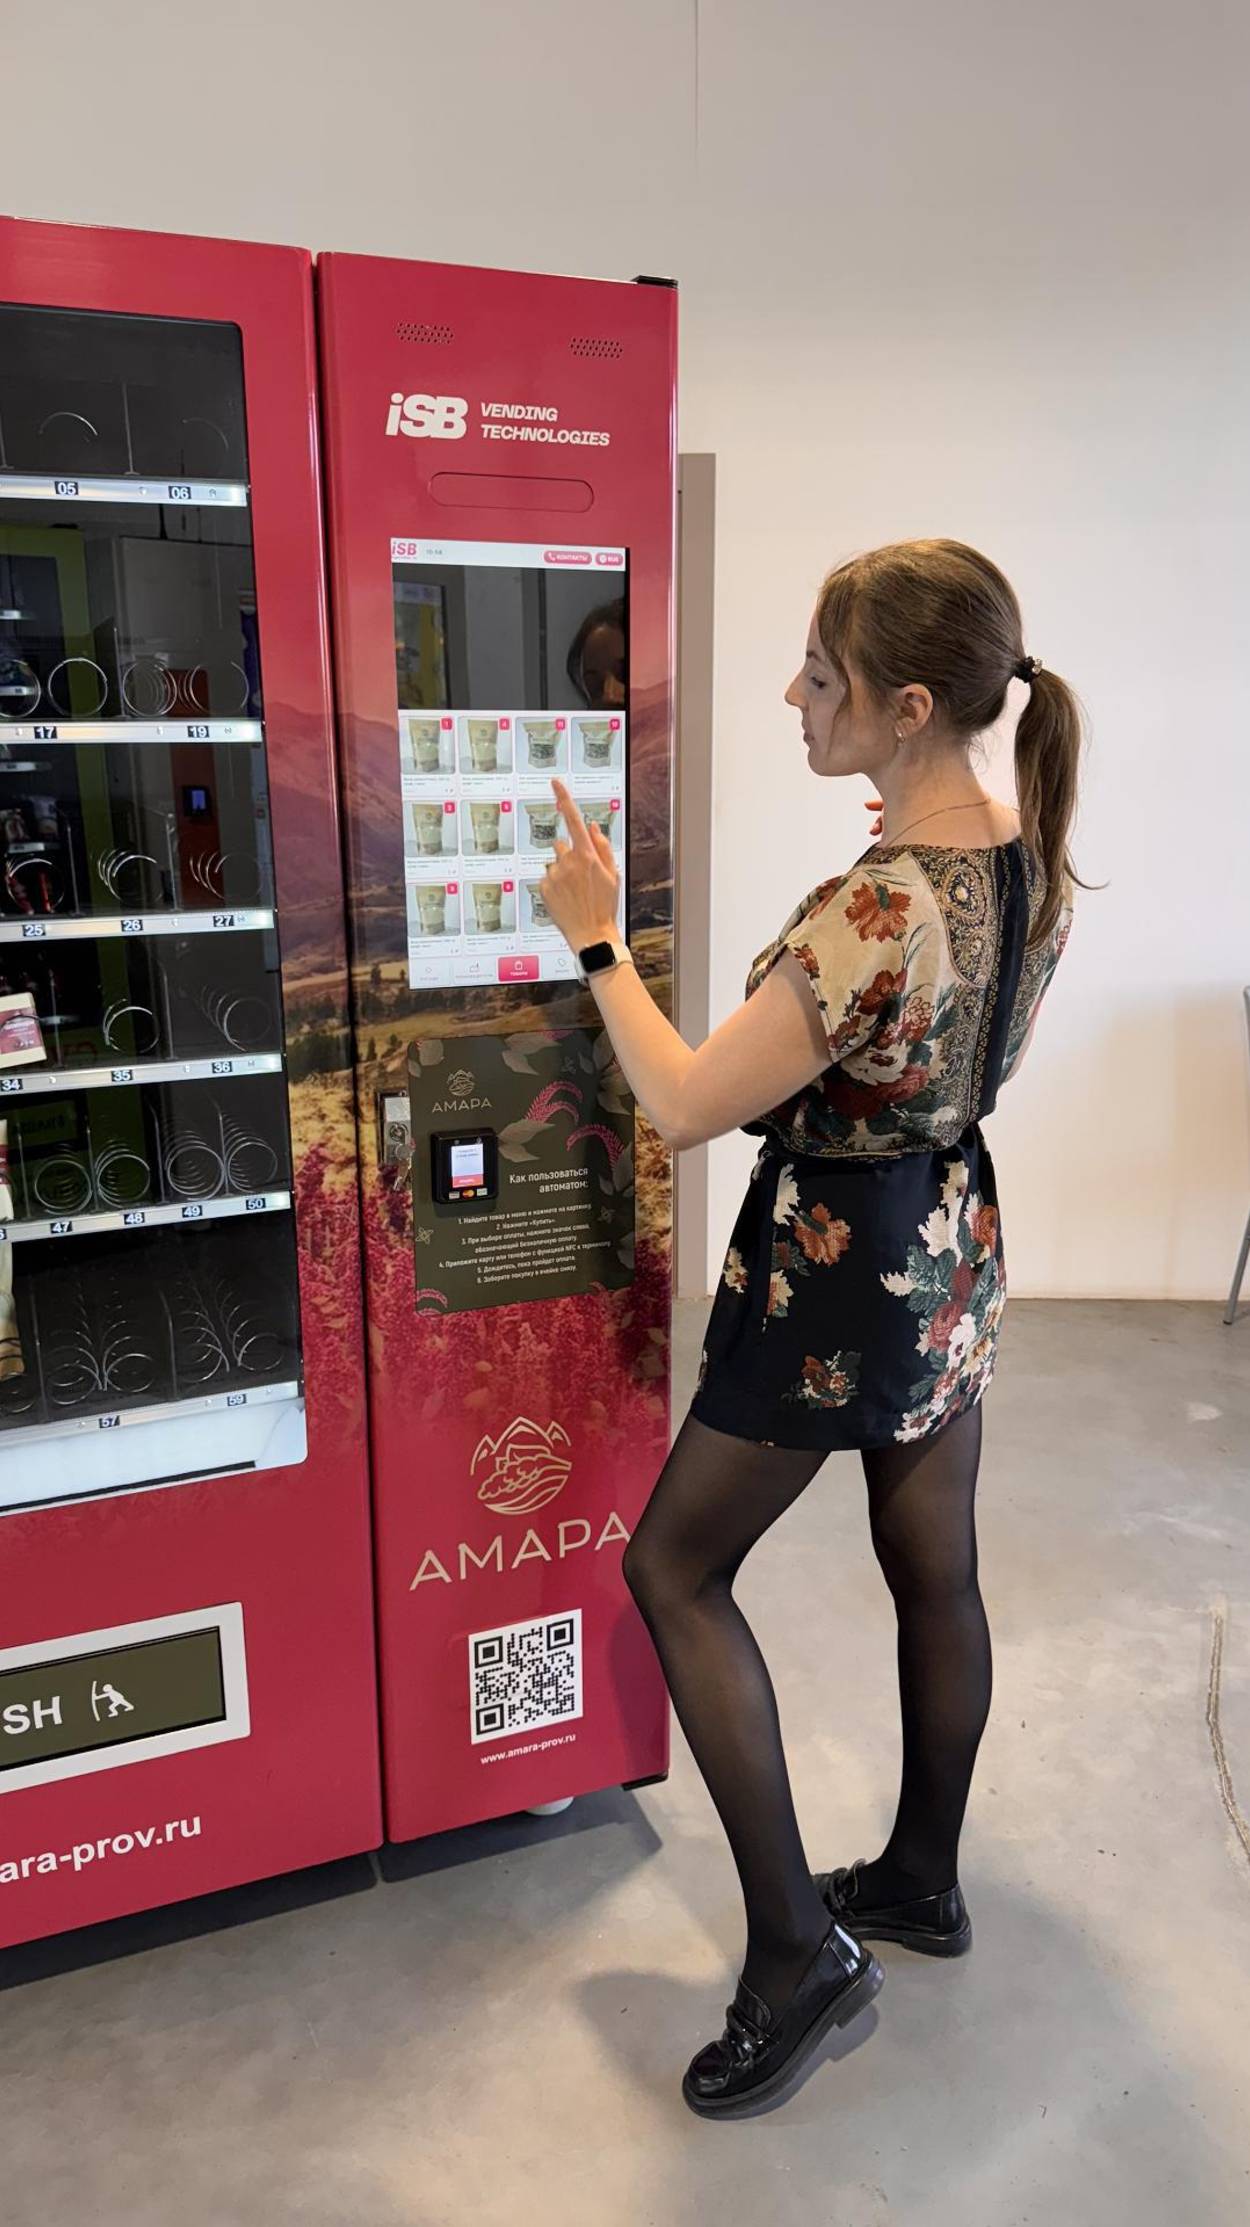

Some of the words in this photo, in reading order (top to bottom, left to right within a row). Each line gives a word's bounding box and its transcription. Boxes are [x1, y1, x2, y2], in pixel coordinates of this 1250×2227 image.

[385, 392, 468, 440] iSB
[480, 402, 558, 422] VENDING
[481, 424, 610, 447] TECHNOLOGIES
[57, 482, 77, 496] 05
[171, 487, 190, 500] 06
[392, 541, 417, 556] iSB
[36, 726, 55, 739] 17
[190, 725, 208, 738] 19
[123, 919, 141, 931] 26
[215, 915, 233, 927] 27
[25, 924, 43, 936] 25
[213, 1062, 230, 1073] 36
[114, 1070, 131, 1081] 35
[1, 1079, 21, 1091] 34
[432, 1097, 493, 1113] АМАРА
[509, 1174, 527, 1184] Как
[528, 1168, 589, 1182] пользоваться
[539, 1181, 589, 1193] автоматом:
[247, 1198, 264, 1210] 50
[183, 1206, 201, 1217] 49
[125, 1213, 143, 1224] 48
[464, 1216, 488, 1224] Найдите
[51, 1221, 70, 1233] 47
[229, 1394, 245, 1406] 59
[101, 1416, 118, 1427] 57
[409, 1511, 631, 1591] АМАРА
[3, 1696, 63, 1735] SH
[480, 1733, 576, 1765] www.amara-prov.ru
[0, 1816, 202, 1884] ara-prov.ru
